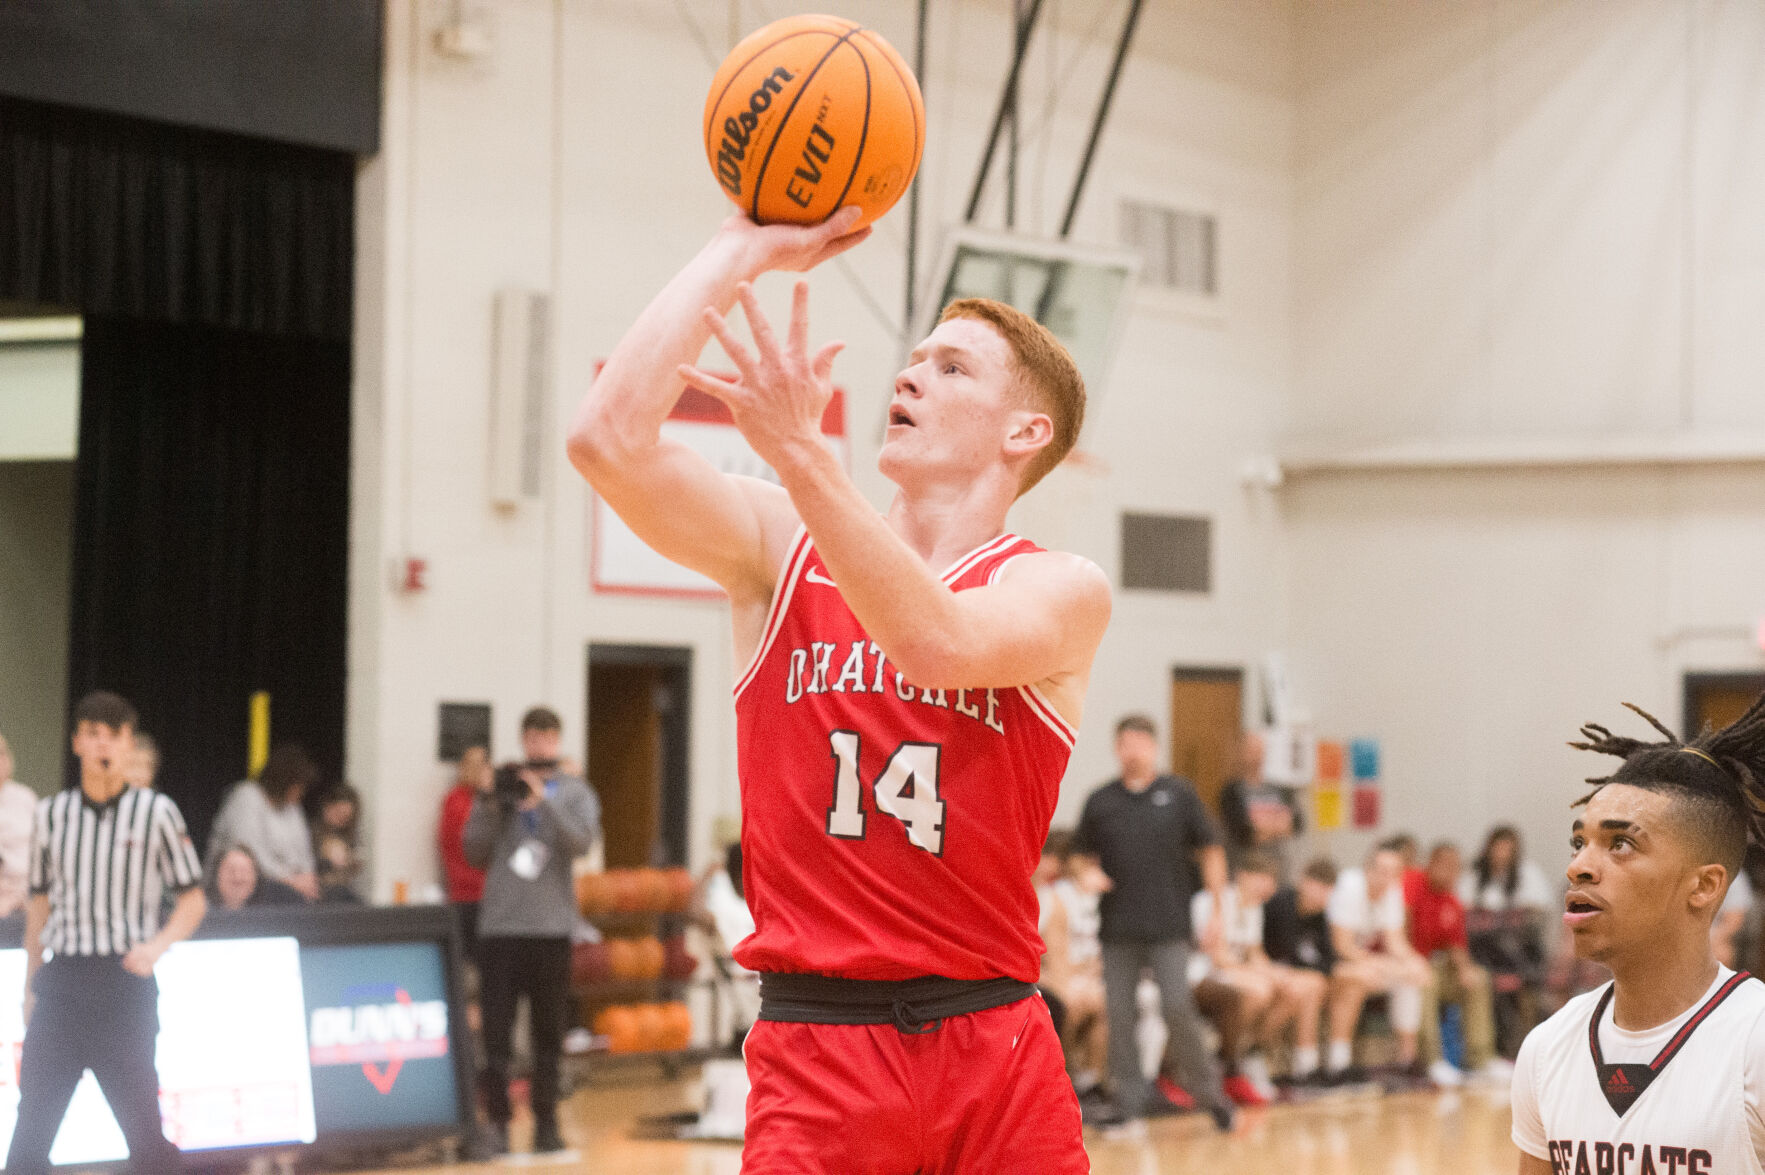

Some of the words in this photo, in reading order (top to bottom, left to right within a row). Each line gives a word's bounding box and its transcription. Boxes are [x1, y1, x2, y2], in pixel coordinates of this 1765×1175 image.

[717, 66, 795, 196] Wilson
[785, 123, 836, 209] EVO
[825, 728, 947, 858] 14
[1548, 1140, 1713, 1175] BEARCATS
